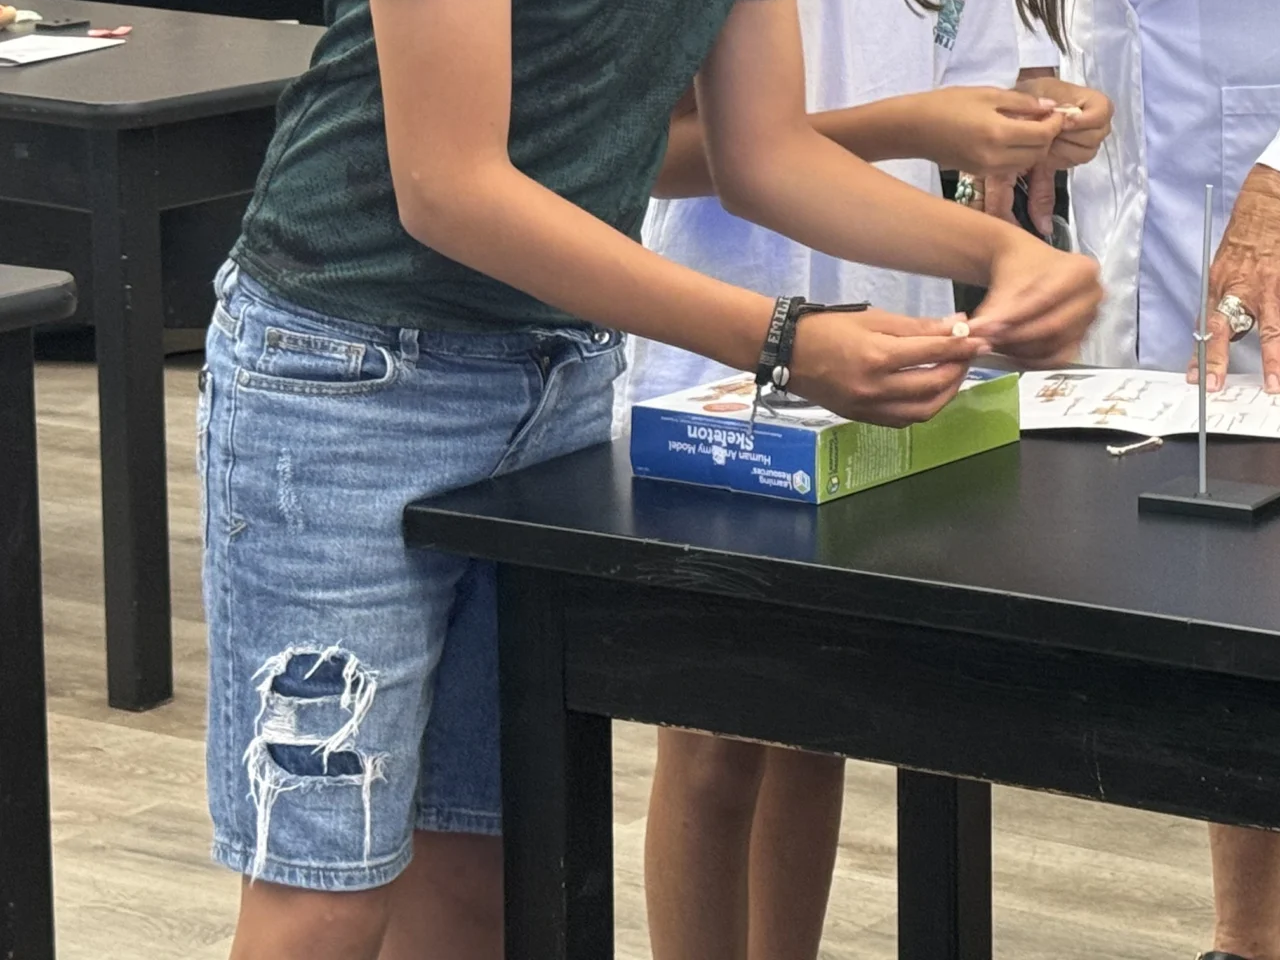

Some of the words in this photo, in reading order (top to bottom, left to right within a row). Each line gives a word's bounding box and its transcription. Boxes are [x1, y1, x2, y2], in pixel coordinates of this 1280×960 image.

[687, 425, 754, 451] Skeleton
[668, 440, 696, 454] Model
[738, 451, 772, 466] Human
[759, 475, 793, 491] Learning
